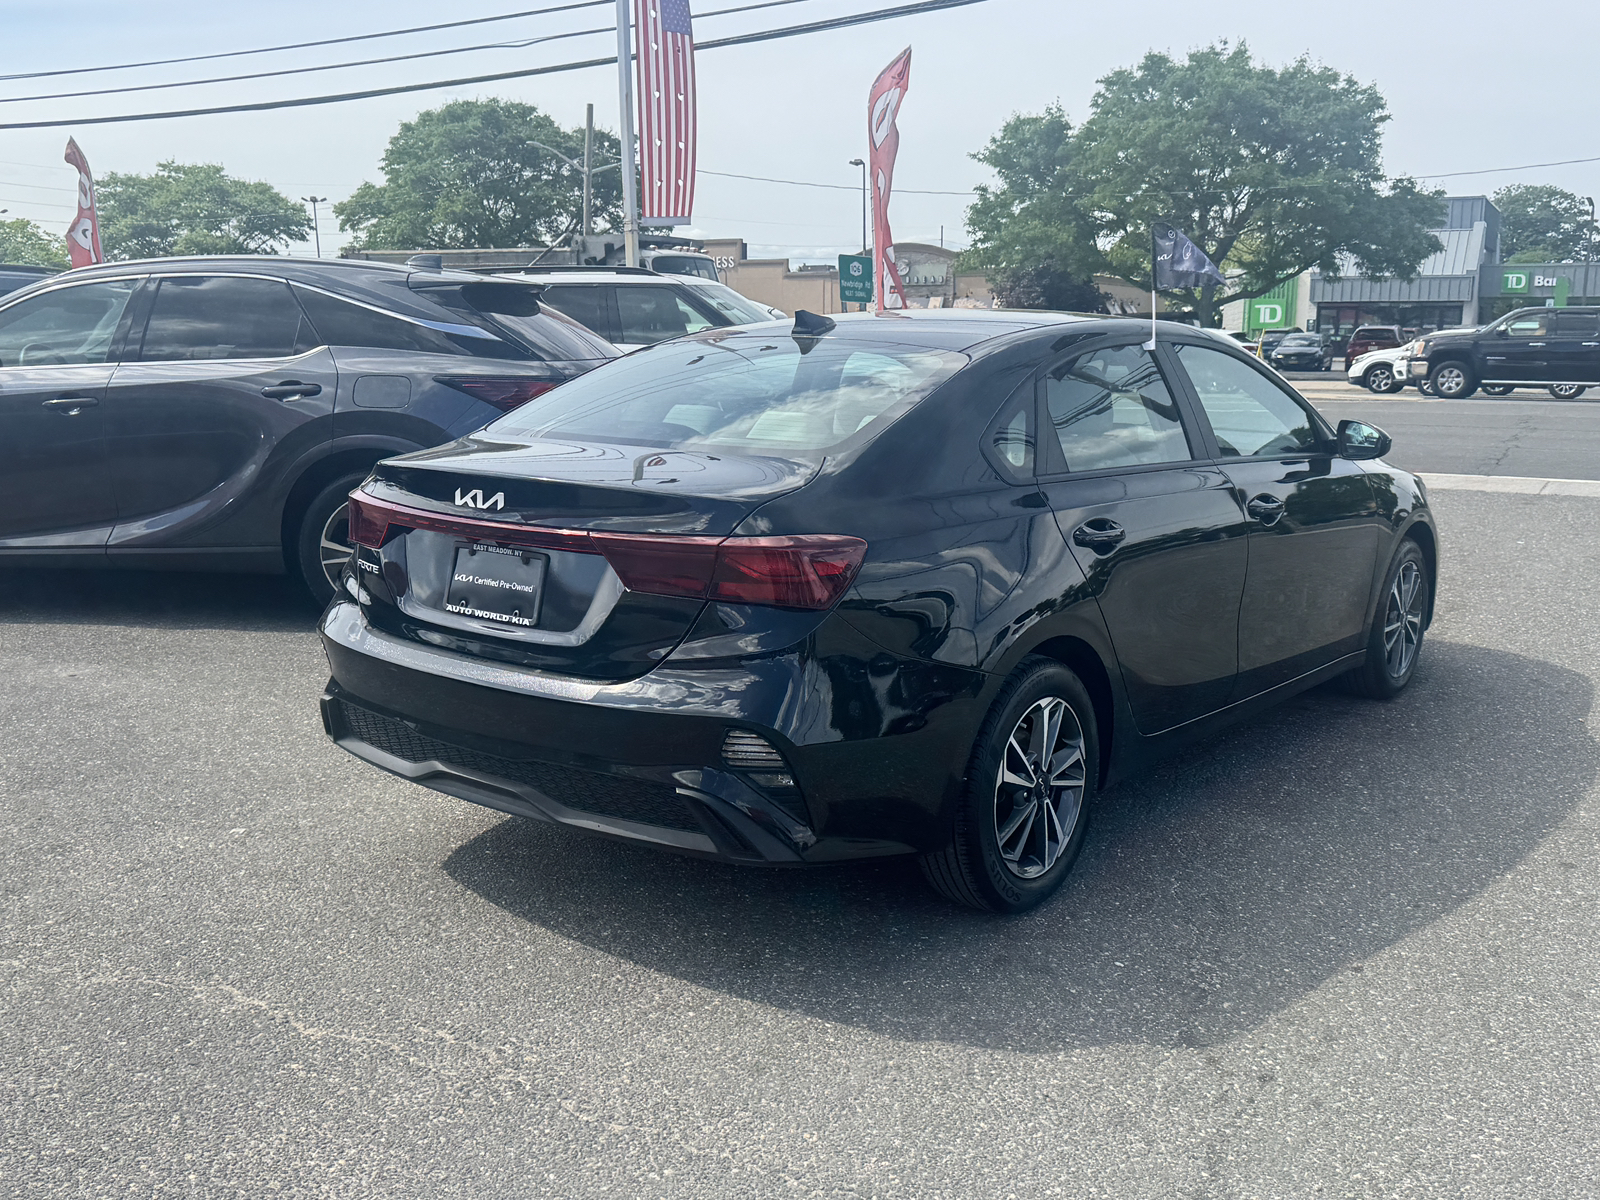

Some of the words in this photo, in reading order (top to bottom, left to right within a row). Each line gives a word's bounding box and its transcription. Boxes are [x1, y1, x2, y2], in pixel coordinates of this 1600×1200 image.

[1504, 274, 1526, 289] TD
[1254, 304, 1282, 324] TD
[454, 487, 505, 511] KIA
[473, 543, 487, 552] EAST
[514, 549, 523, 557] NY
[358, 558, 380, 574] FORTE
[454, 573, 473, 583] KIA
[474, 576, 499, 588] Certified
[500, 580, 533, 593] Pre-Owned
[446, 603, 472, 615] AUTO
[474, 609, 509, 622] WORLD
[512, 616, 530, 626] KIA
[989, 859, 1023, 902] SOLUS
